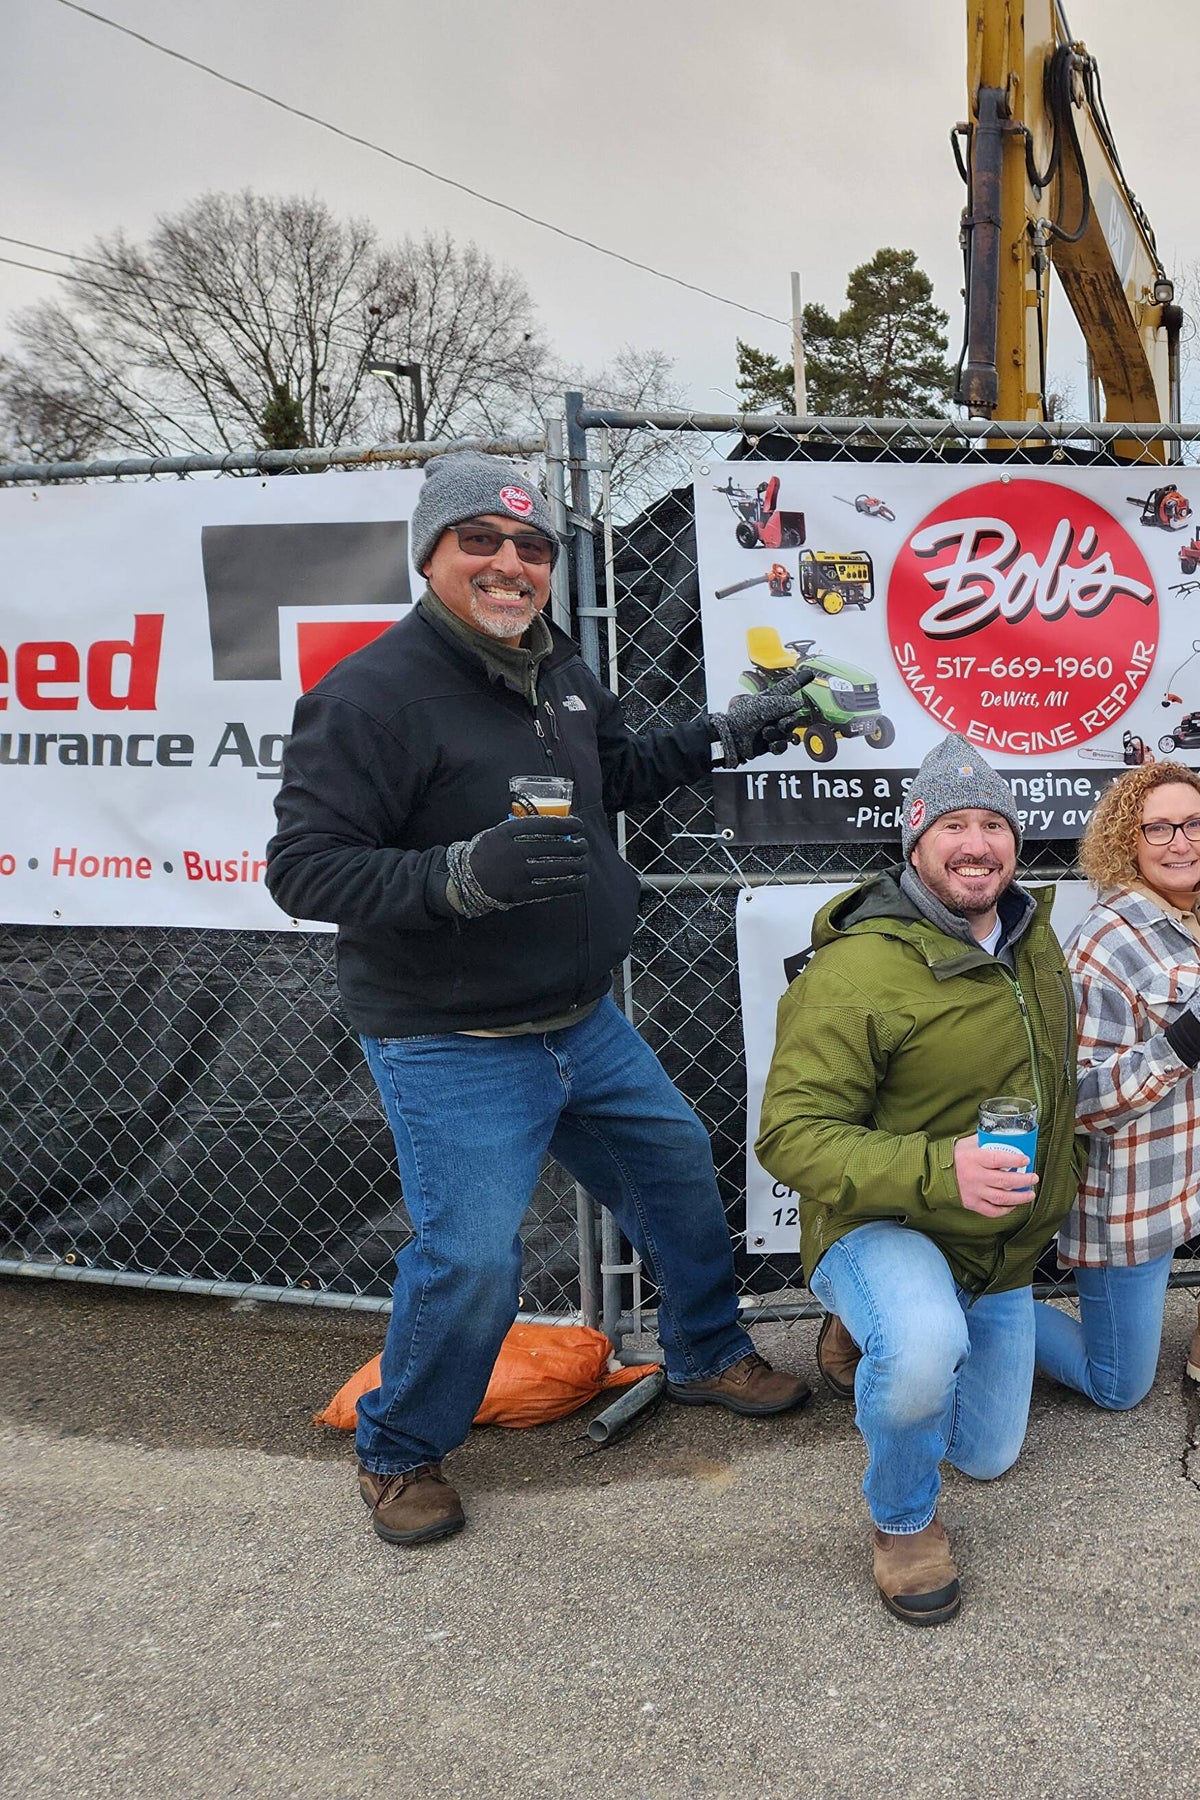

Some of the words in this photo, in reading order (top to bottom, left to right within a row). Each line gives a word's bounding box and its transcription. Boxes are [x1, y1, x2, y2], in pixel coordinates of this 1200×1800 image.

[909, 517, 1153, 640] Bob's
[0, 613, 164, 711] ed
[936, 656, 1113, 680] 517-669-1960
[894, 642, 957, 729] SMALL
[966, 720, 1077, 753] ENGINE
[1080, 640, 1155, 733] REPAIR
[980, 690, 1040, 708] DeWitt,
[1044, 691, 1069, 707] MI
[0, 733, 194, 767] urance
[747, 773, 768, 800] If
[778, 773, 802, 799] it
[813, 772, 864, 799] has
[874, 777, 891, 798] a
[1002, 771, 1101, 803] ngine,
[52, 847, 152, 879] Home
